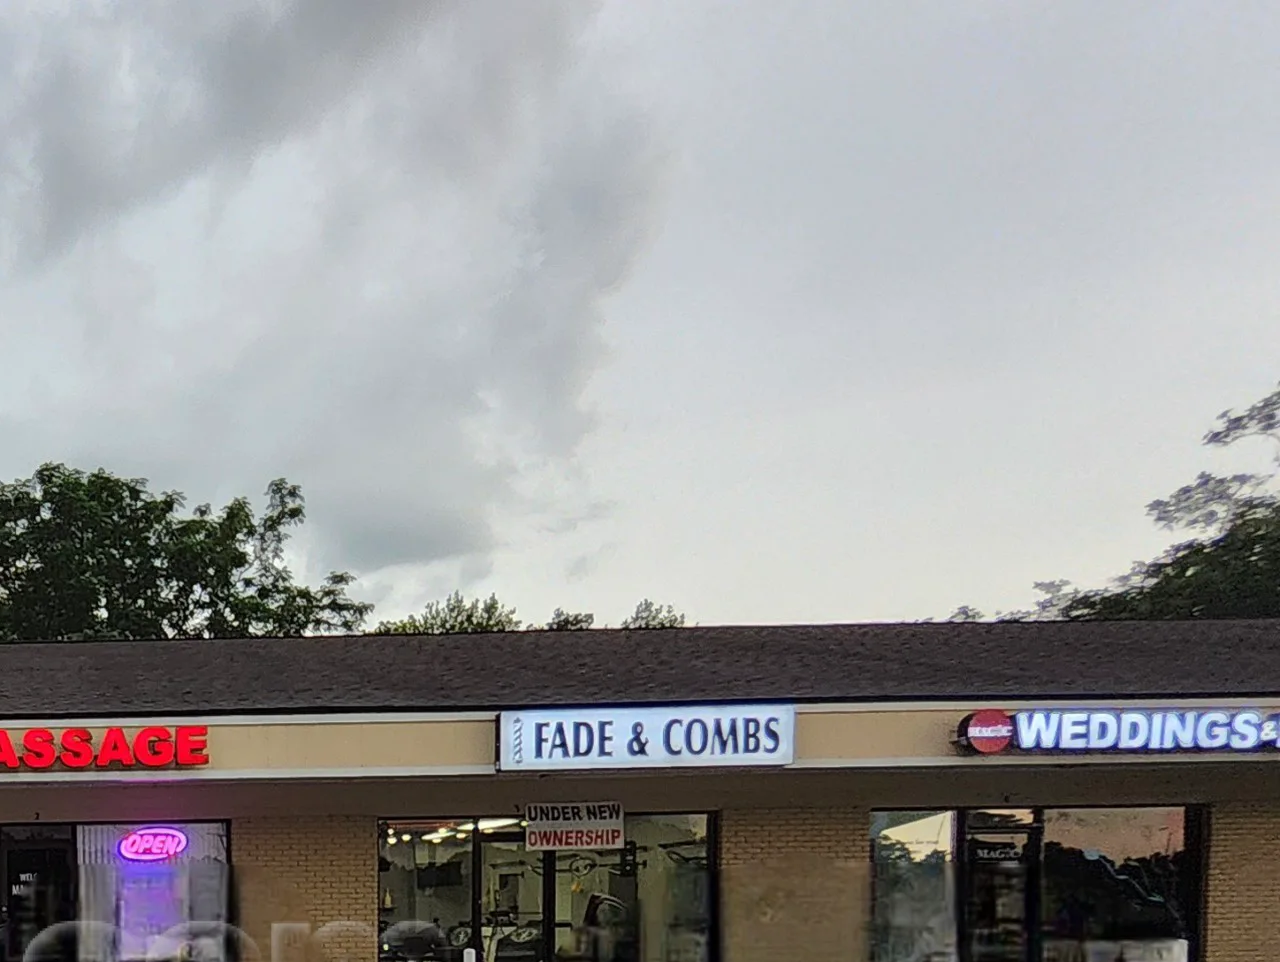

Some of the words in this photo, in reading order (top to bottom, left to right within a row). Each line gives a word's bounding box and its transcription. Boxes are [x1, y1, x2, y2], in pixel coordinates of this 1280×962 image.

[534, 720, 614, 759] FADE
[627, 721, 649, 756] &
[663, 717, 781, 756] COMBS
[1016, 711, 1262, 749] WEDDINGS
[528, 805, 584, 822] UNDER
[587, 803, 621, 821] NEW
[126, 833, 180, 855] OPEN
[528, 828, 622, 847] OWNERSHIP
